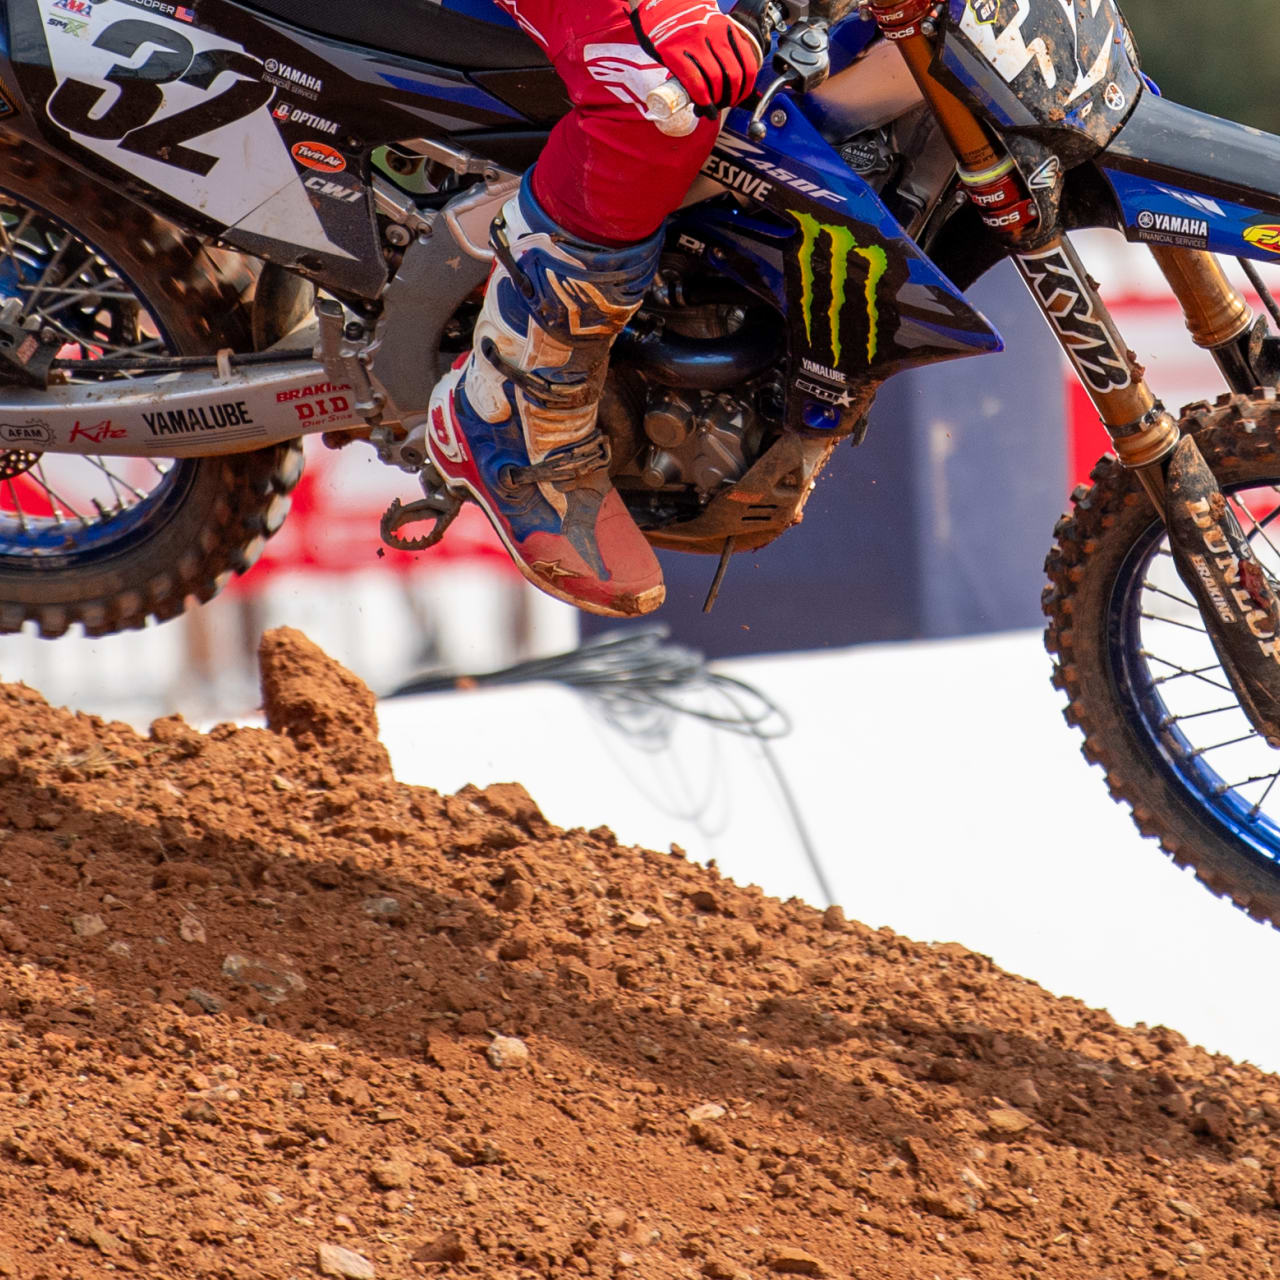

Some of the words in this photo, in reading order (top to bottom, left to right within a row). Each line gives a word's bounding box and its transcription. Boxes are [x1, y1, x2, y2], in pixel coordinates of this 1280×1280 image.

[278, 62, 323, 92] YAMAHA
[46, 19, 276, 177] 32
[291, 109, 337, 135] OPTIMA
[298, 146, 325, 161] Twin
[324, 154, 342, 167] Air
[1154, 214, 1208, 237] YAMAHA
[1138, 231, 1174, 244] FINANCIAL
[1175, 237, 1207, 249] SERVICES
[802, 357, 847, 384] YAMALUBE
[142, 401, 254, 436] YAMALUBE
[8, 428, 42, 437] AFAM
[68, 420, 128, 443] Kite
